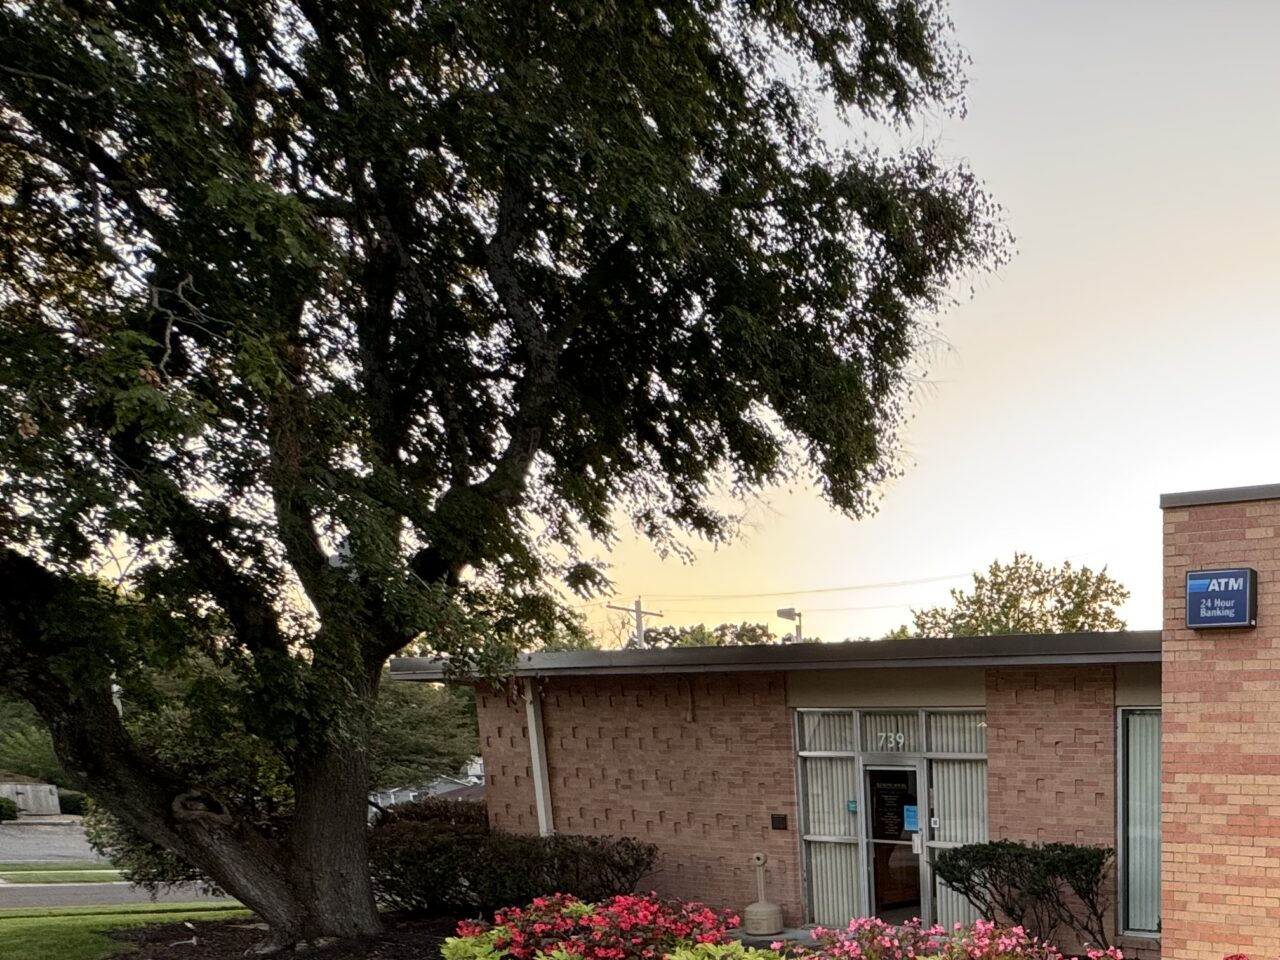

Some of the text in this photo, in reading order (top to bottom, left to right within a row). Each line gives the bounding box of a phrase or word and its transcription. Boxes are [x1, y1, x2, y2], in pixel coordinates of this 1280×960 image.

[1207, 577, 1244, 592] ATM
[1200, 598, 1235, 608] 24 Hour
[1200, 607, 1235, 618] Banking
[877, 732, 905, 748] 739
